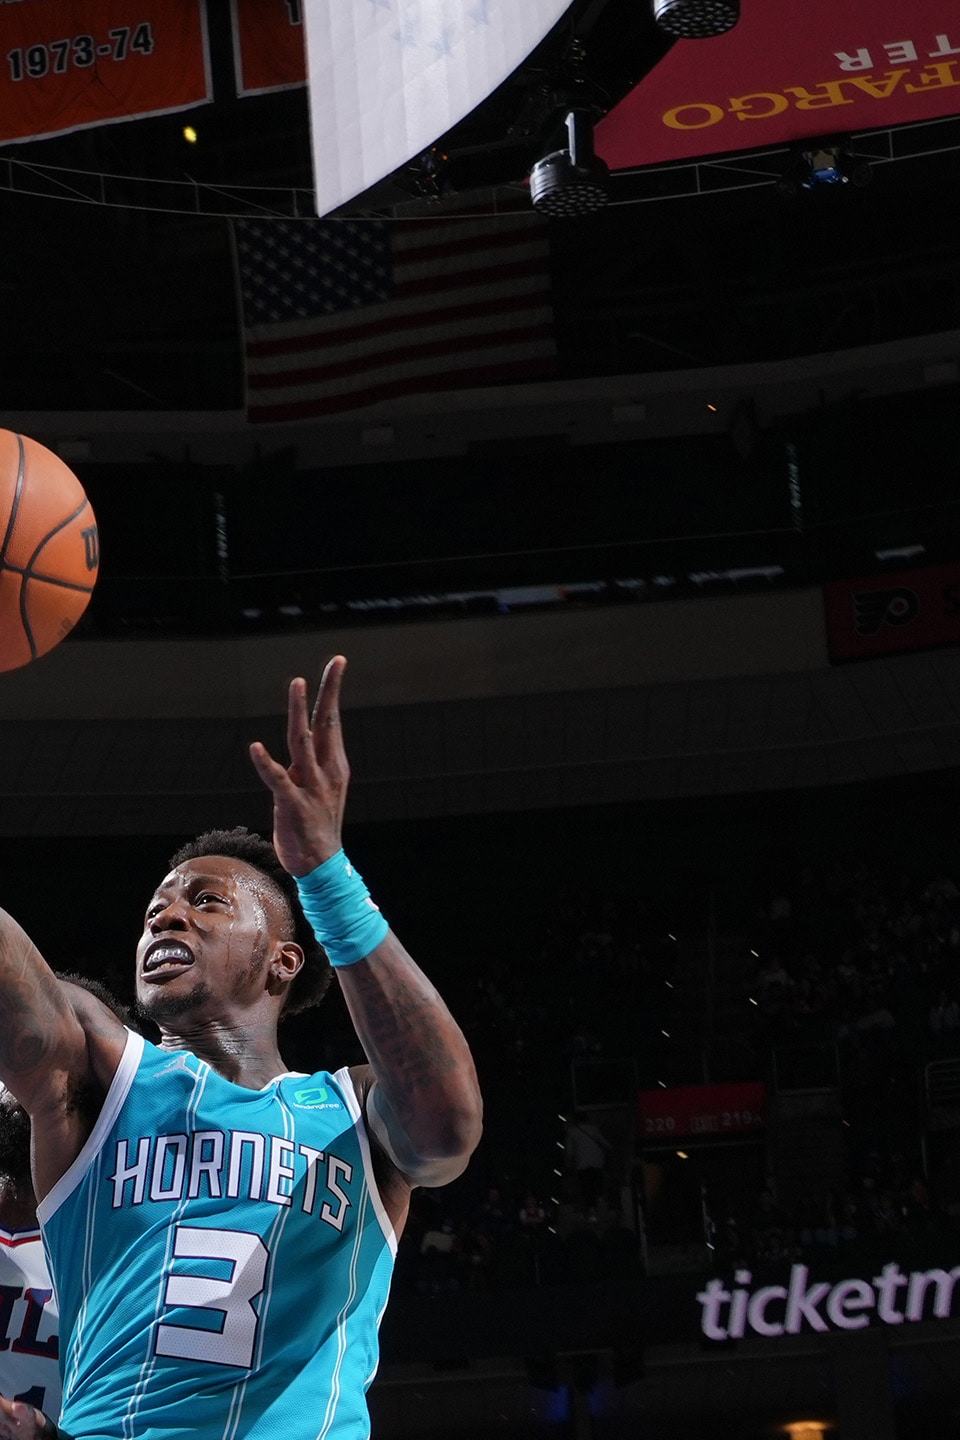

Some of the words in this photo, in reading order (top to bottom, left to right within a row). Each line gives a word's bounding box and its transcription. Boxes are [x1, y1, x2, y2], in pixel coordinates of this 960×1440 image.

[8, 22, 155, 81] 1973-74
[662, 61, 960, 130] FARGO
[109, 1129, 354, 1233] HORNETS
[155, 1226, 271, 1369] 3
